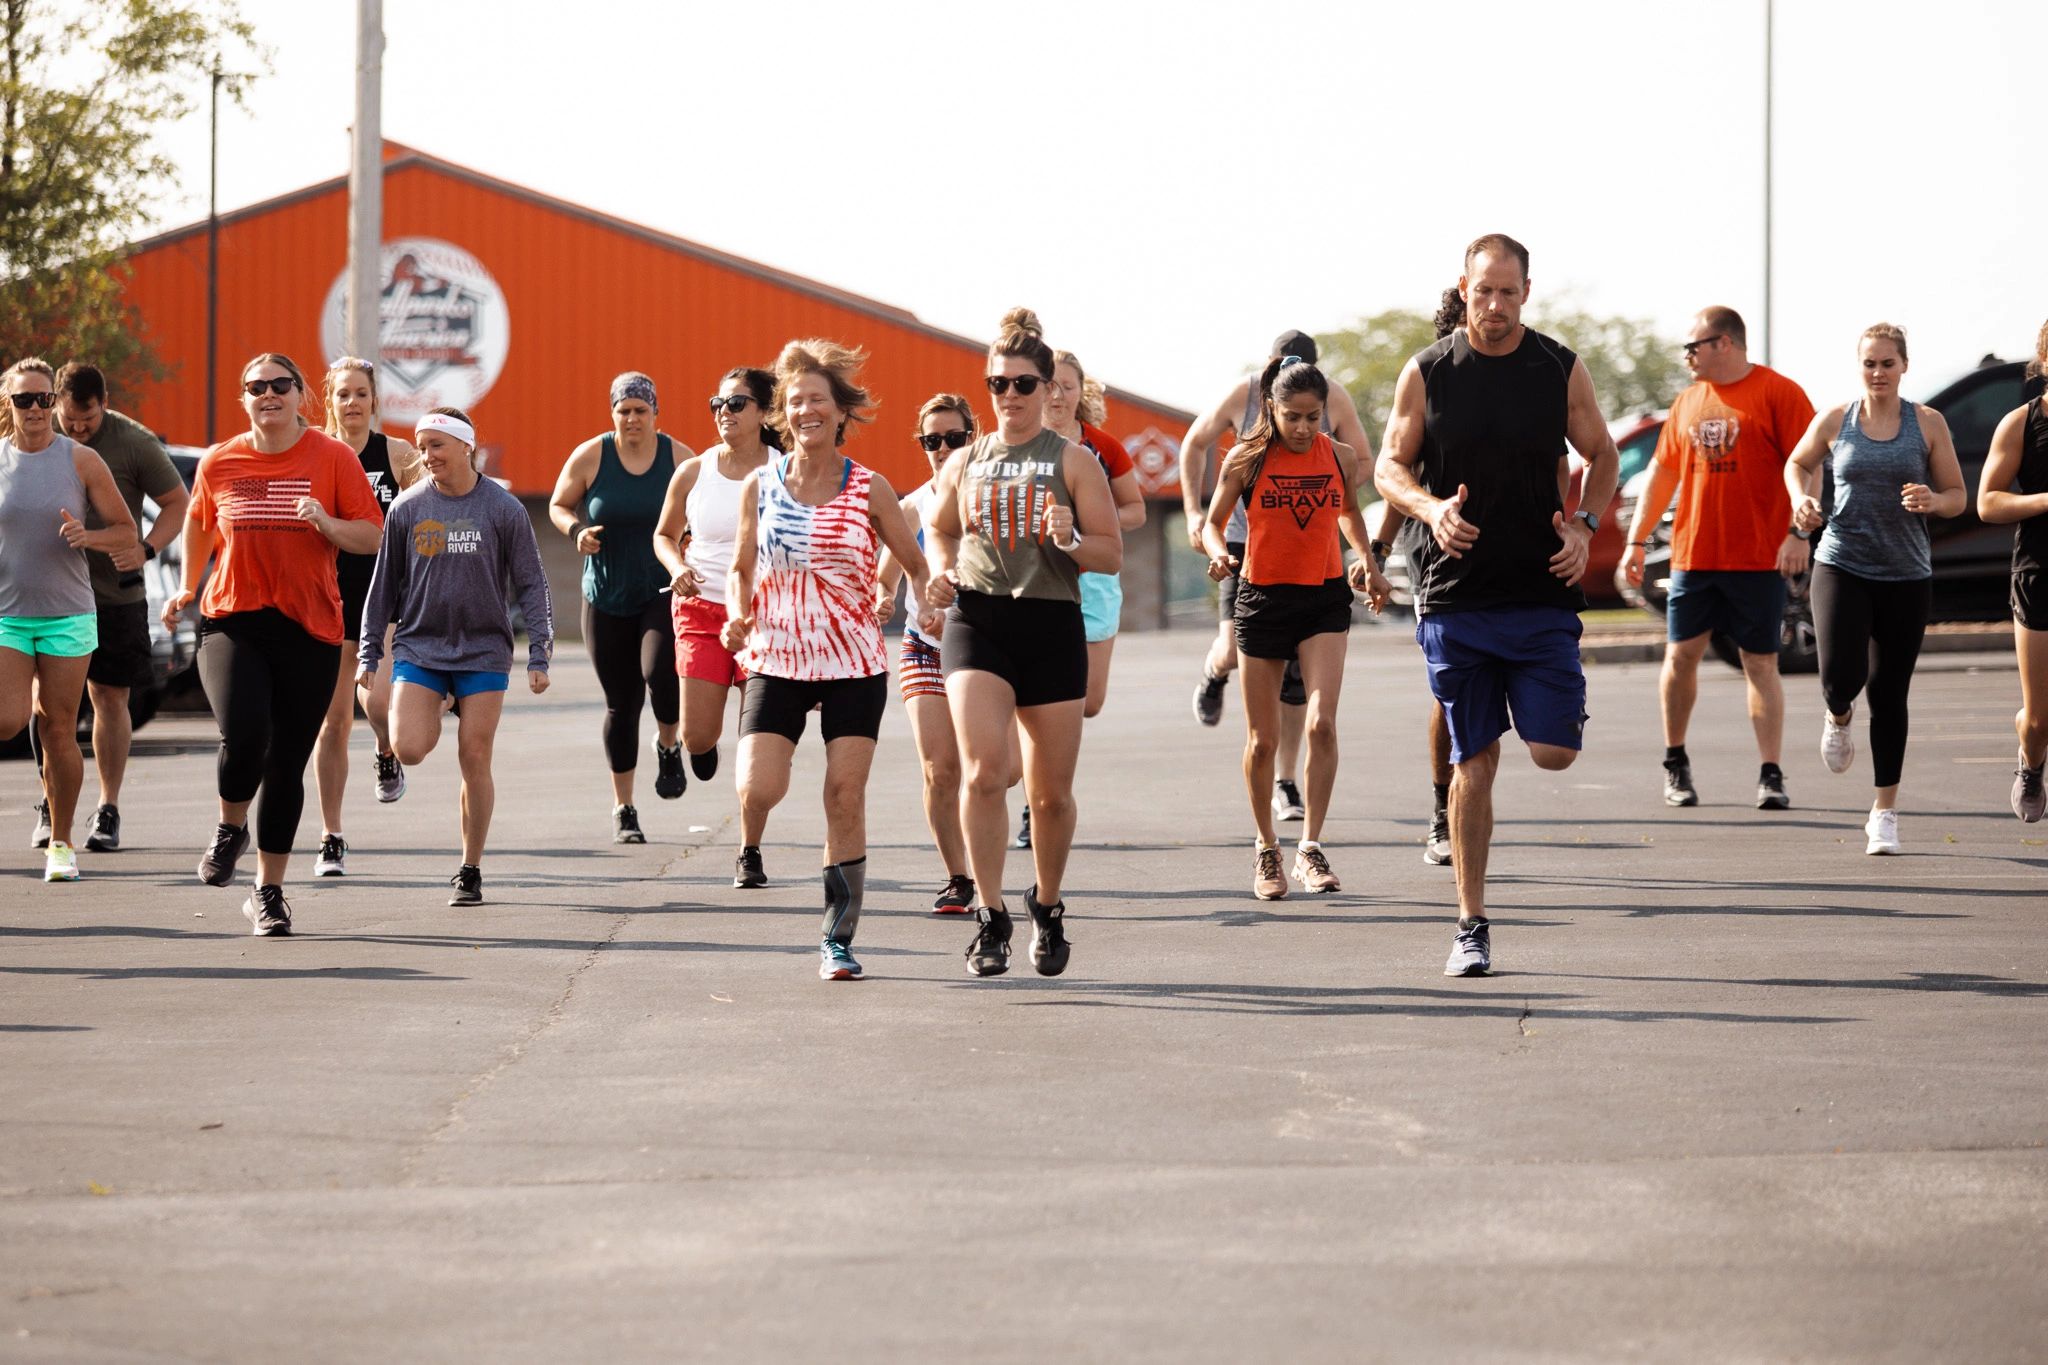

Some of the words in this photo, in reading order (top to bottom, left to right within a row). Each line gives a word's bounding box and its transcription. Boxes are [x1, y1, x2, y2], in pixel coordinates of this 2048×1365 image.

[1018, 484, 1027, 497] 100
[1018, 499, 1026, 520] PULL
[1034, 490, 1045, 513] MILE
[1260, 494, 1341, 508] BRAVE
[983, 501, 993, 533] SQUATS
[1000, 499, 1009, 521] PUSH
[1000, 522, 1009, 538] UPS
[1018, 521, 1026, 538] UPS
[1032, 514, 1042, 534] RUN
[447, 531, 482, 542] ALAFIA
[447, 542, 477, 553] RIVER
